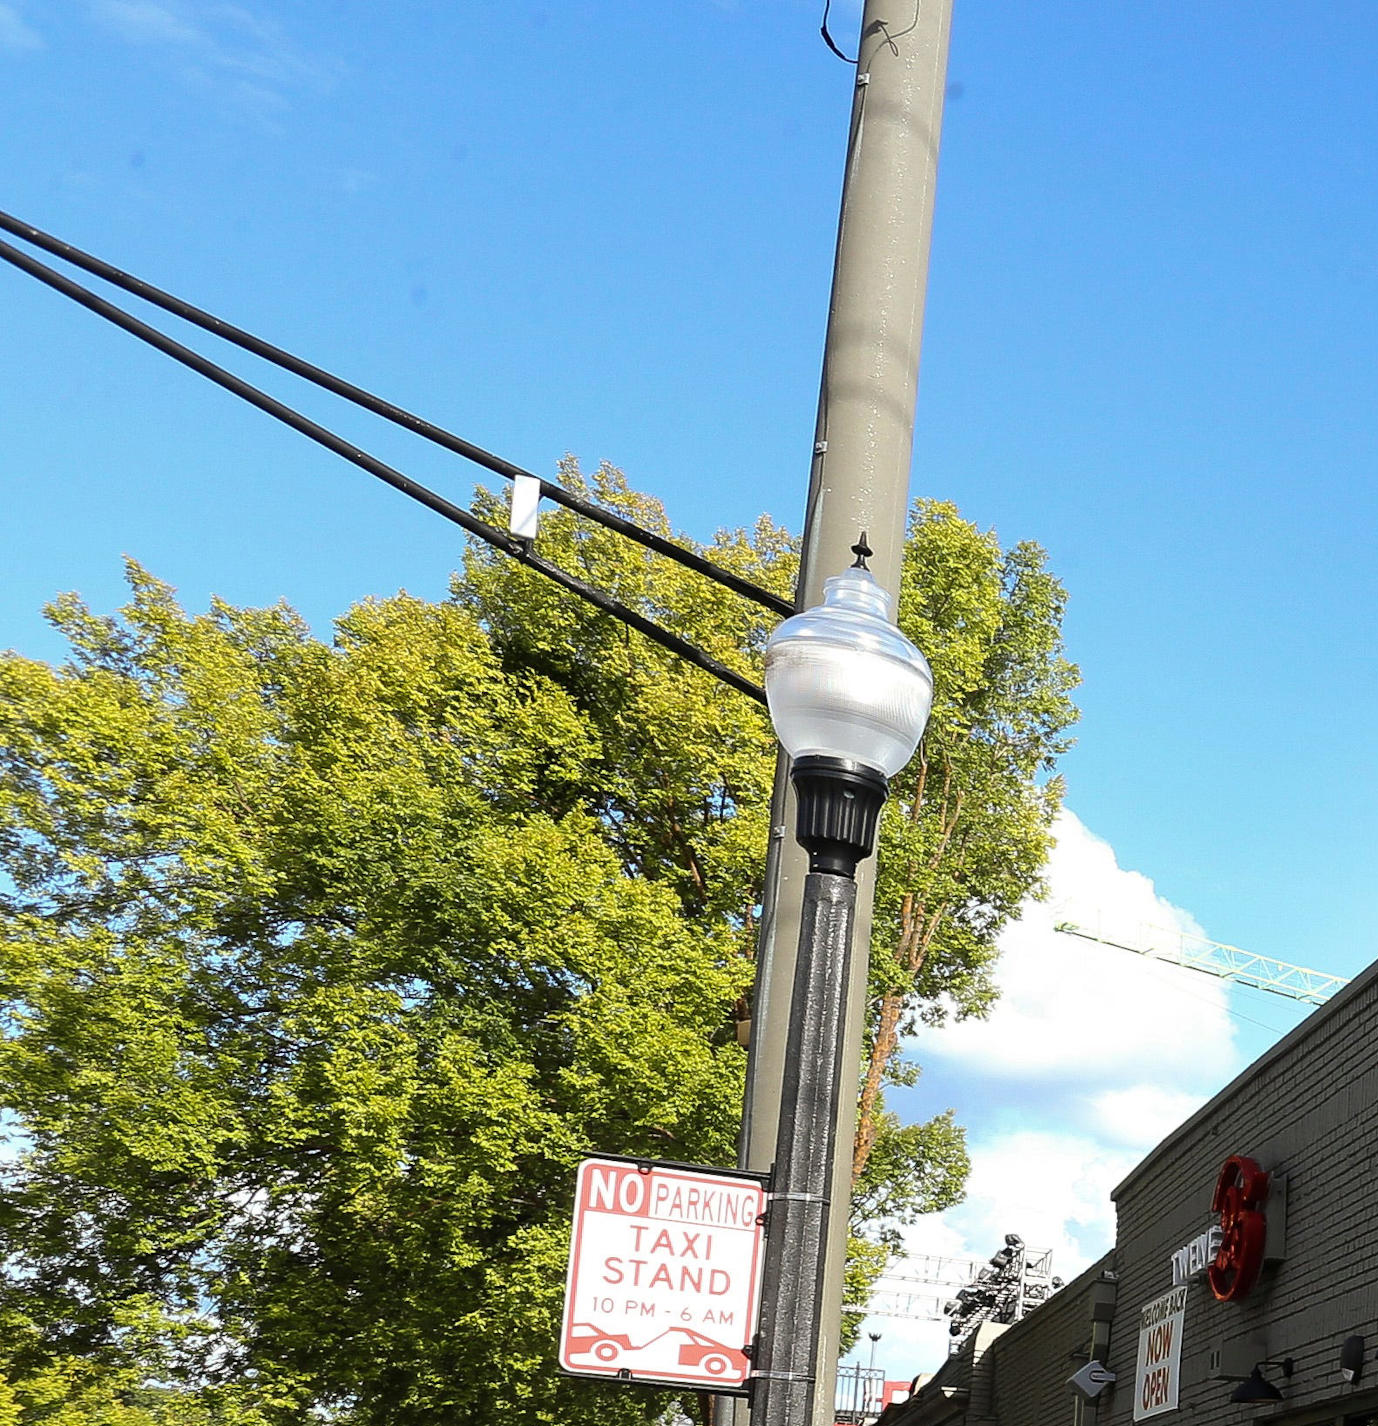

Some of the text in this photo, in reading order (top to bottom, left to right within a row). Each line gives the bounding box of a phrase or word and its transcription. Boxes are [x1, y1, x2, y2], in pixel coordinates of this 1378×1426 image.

[588, 1168, 755, 1228] NO PARKING
[630, 1224, 713, 1260] TAXI
[602, 1256, 731, 1296] STAND
[592, 1297, 615, 1314] 10
[625, 1300, 656, 1318] PM
[680, 1307, 693, 1322] 6
[702, 1308, 734, 1326] AM
[1146, 1321, 1174, 1367] NOW
[1142, 1367, 1170, 1411] OPEN
